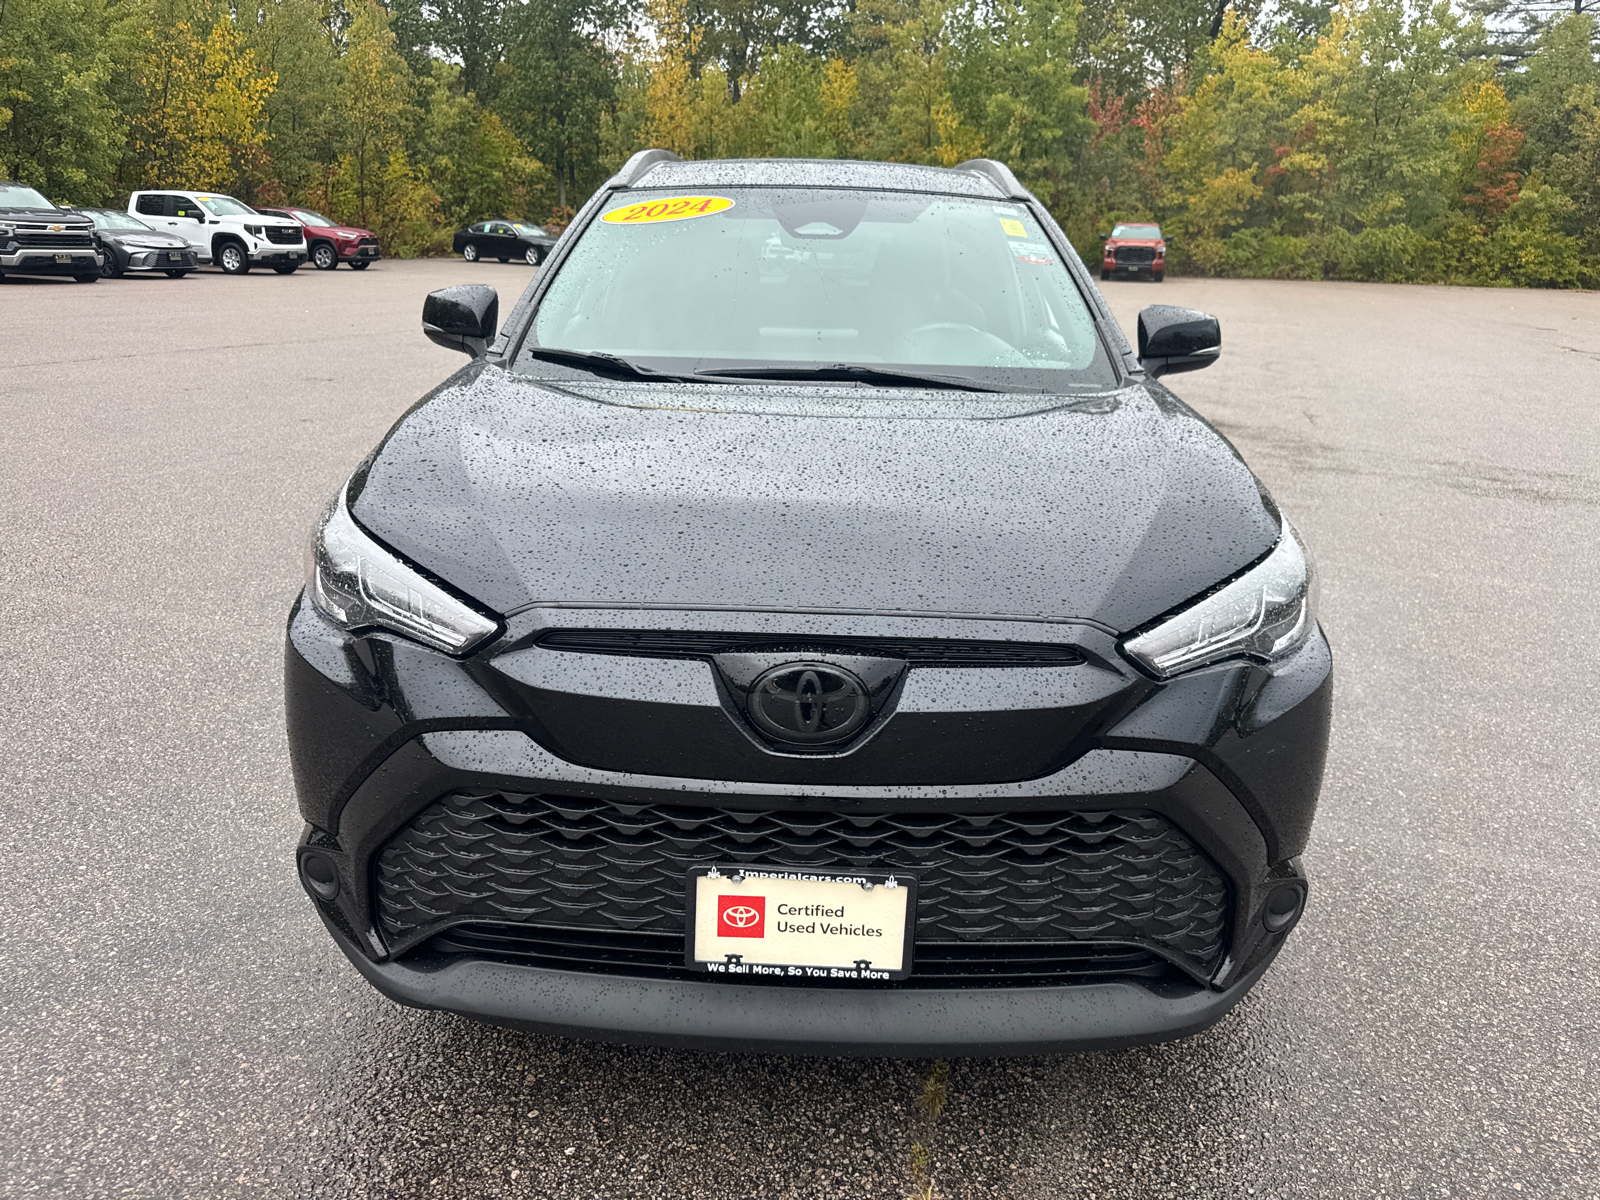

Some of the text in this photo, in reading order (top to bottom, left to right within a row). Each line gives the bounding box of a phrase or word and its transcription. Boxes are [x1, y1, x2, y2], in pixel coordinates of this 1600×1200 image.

[623, 199, 712, 220] 2024
[738, 869, 867, 884] Imperialcars.com
[777, 904, 845, 918] Certified
[777, 921, 883, 937] Used Vehicles
[707, 963, 890, 980] We Sell More, So You Save More
